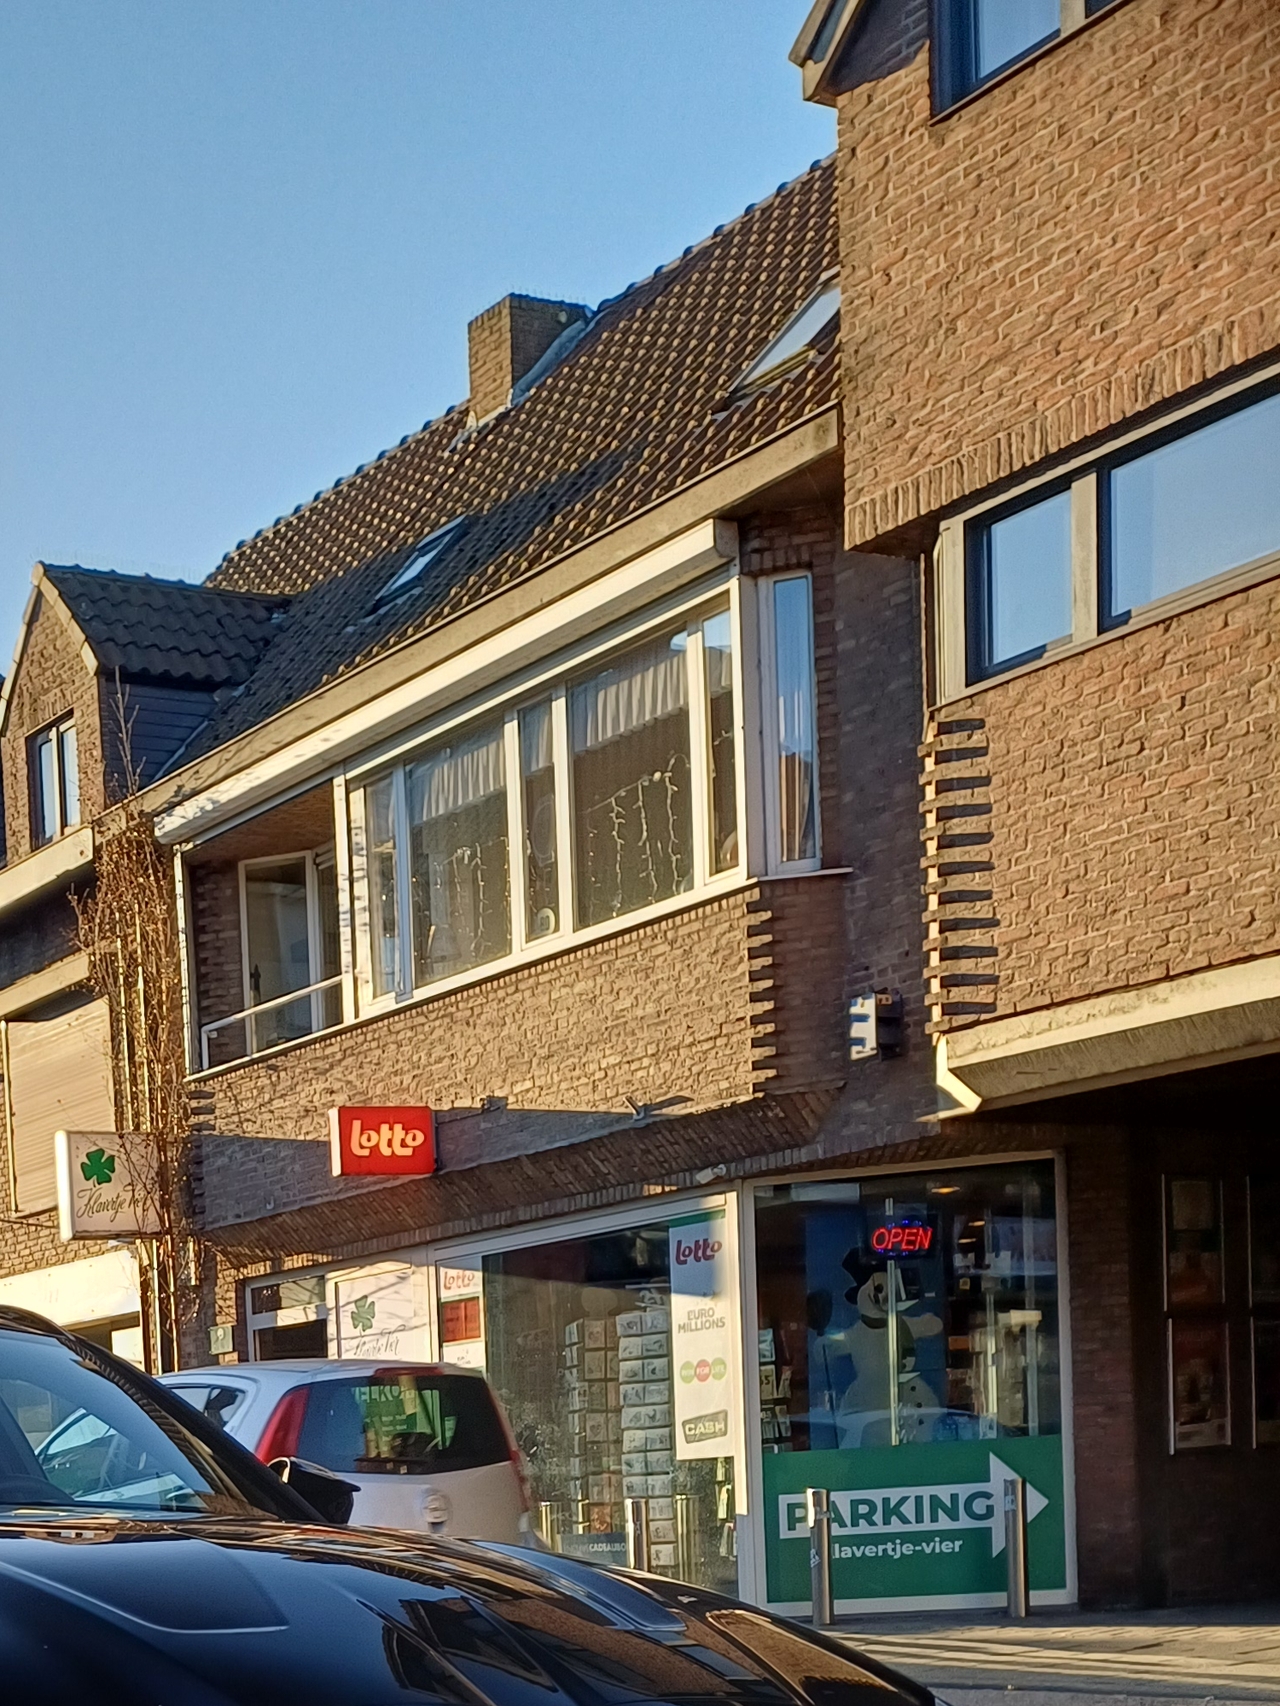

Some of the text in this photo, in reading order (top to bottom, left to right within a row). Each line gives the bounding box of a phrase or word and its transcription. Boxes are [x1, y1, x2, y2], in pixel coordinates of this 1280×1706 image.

[872, 1226, 934, 1250] OPEN
[687, 1307, 715, 1321] EURO
[678, 1316, 726, 1334] MILLIONS
[685, 1421, 725, 1436] CASH
[831, 1536, 963, 1560] lavertje-vier
